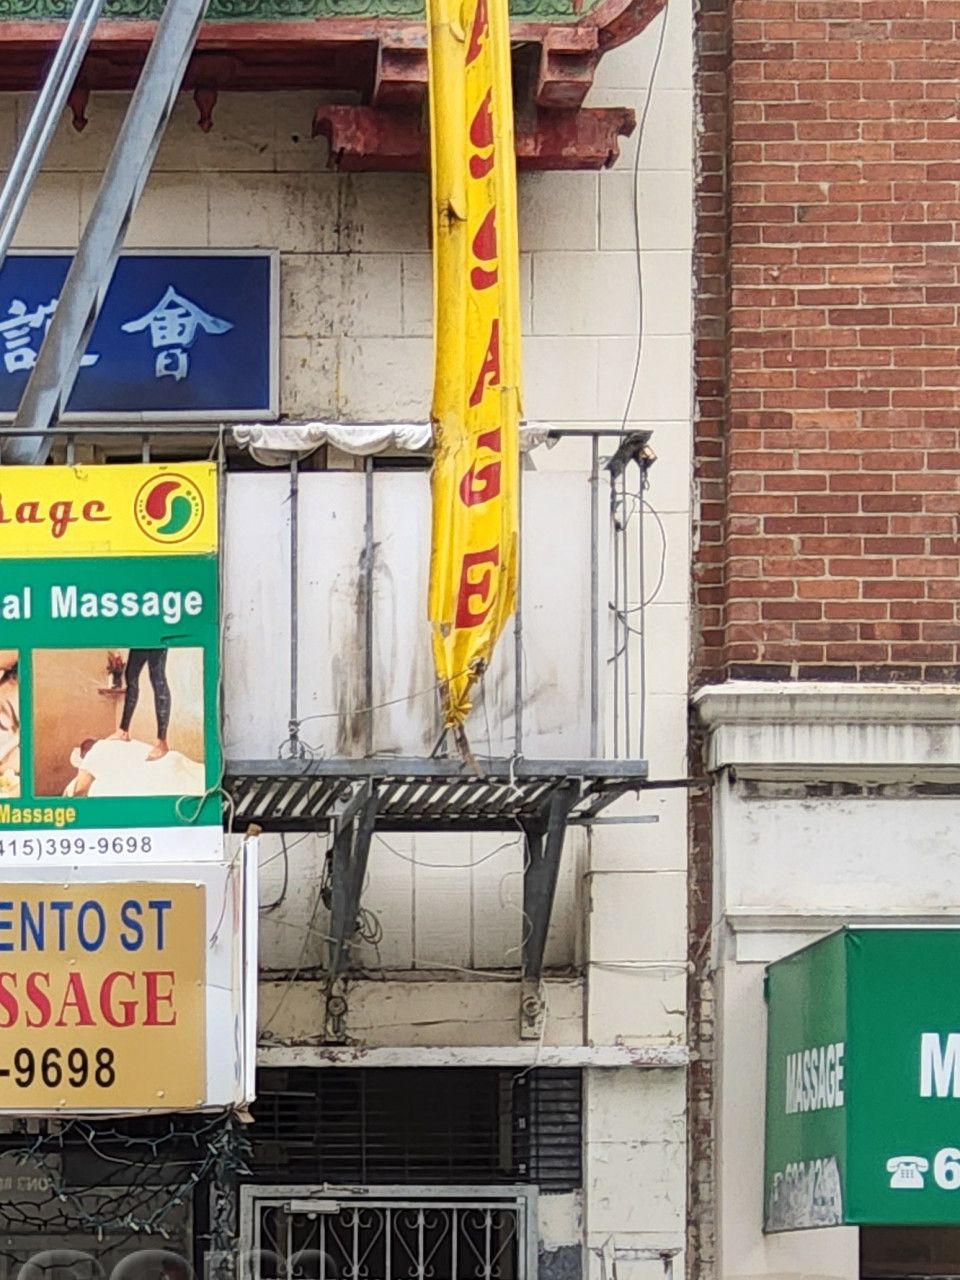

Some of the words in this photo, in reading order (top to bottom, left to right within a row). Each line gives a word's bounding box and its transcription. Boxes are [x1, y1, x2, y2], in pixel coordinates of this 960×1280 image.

[51, 586, 203, 625] Massage
[120, 900, 172, 952] ST
[784, 1041, 845, 1115] MASSAGE
